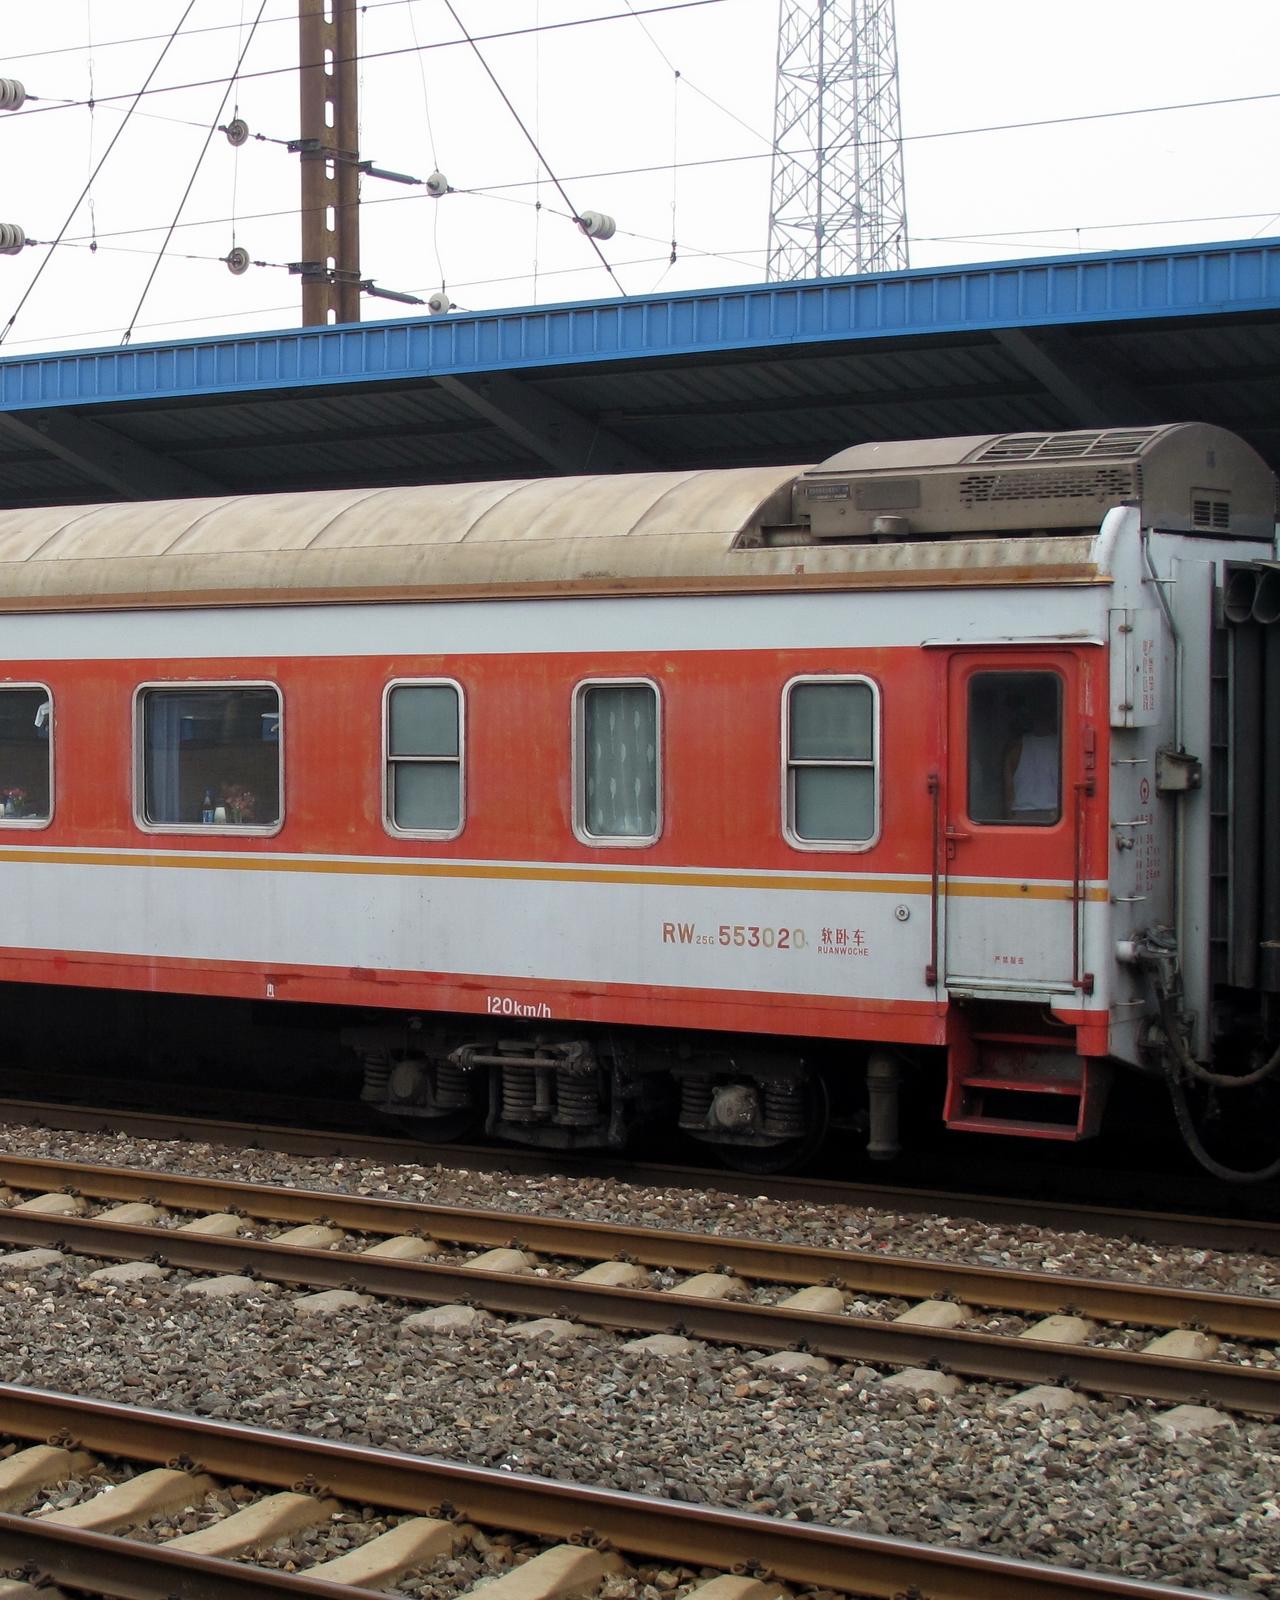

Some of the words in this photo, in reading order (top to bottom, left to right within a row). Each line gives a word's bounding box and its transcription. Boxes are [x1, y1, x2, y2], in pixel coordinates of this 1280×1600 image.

[718, 925, 806, 949] 553020
[821, 927, 866, 947] 软卧车
[817, 946, 870, 957] RUANWOCHE
[487, 996, 552, 1019] 120km/h
